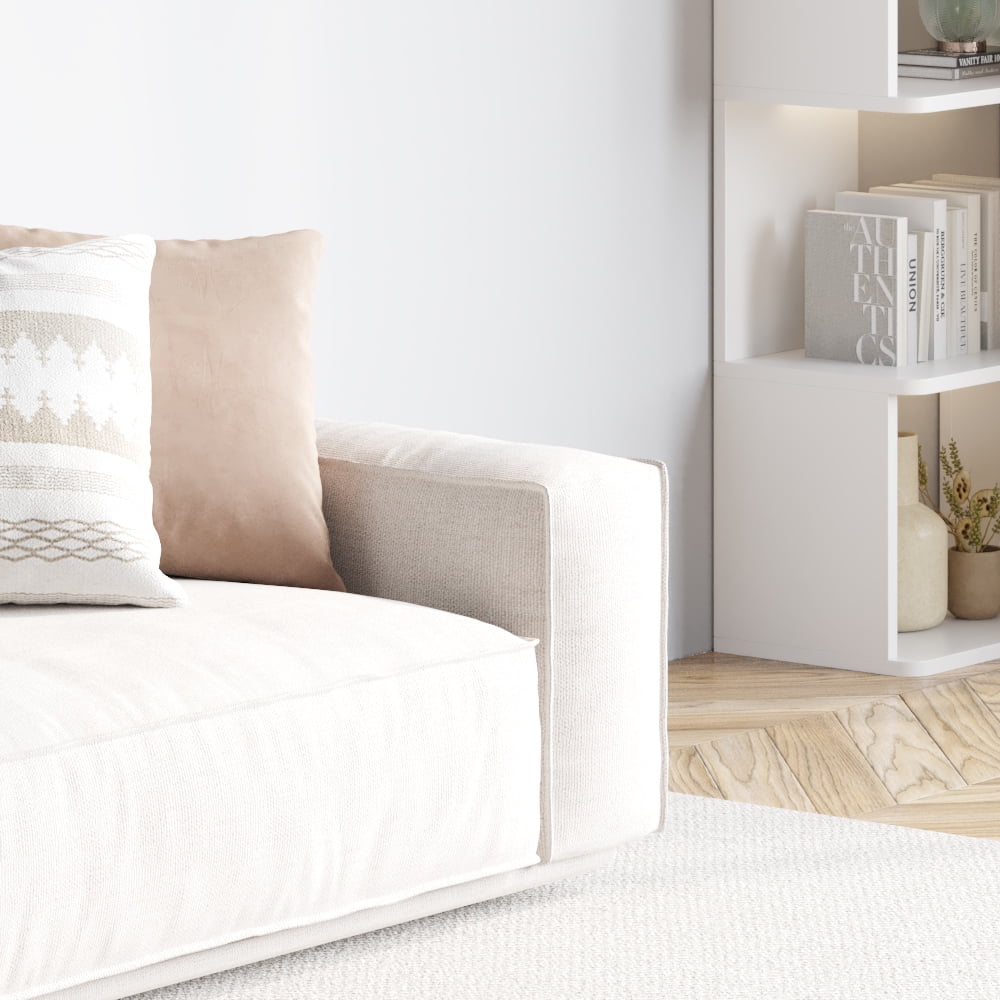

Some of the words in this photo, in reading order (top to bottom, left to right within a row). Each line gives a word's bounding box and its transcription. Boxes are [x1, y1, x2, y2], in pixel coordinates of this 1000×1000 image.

[958, 57, 980, 67] VANITY
[980, 55, 993, 64] FAIR
[843, 222, 855, 233] the
[852, 215, 897, 249] AU
[850, 243, 897, 277] TH
[959, 263, 967, 288] LIVE
[854, 272, 897, 306] EN
[908, 258, 917, 312] UNION
[863, 304, 897, 337] TI
[959, 290, 967, 351] BEAUTIFUL
[856, 333, 897, 367] CS
